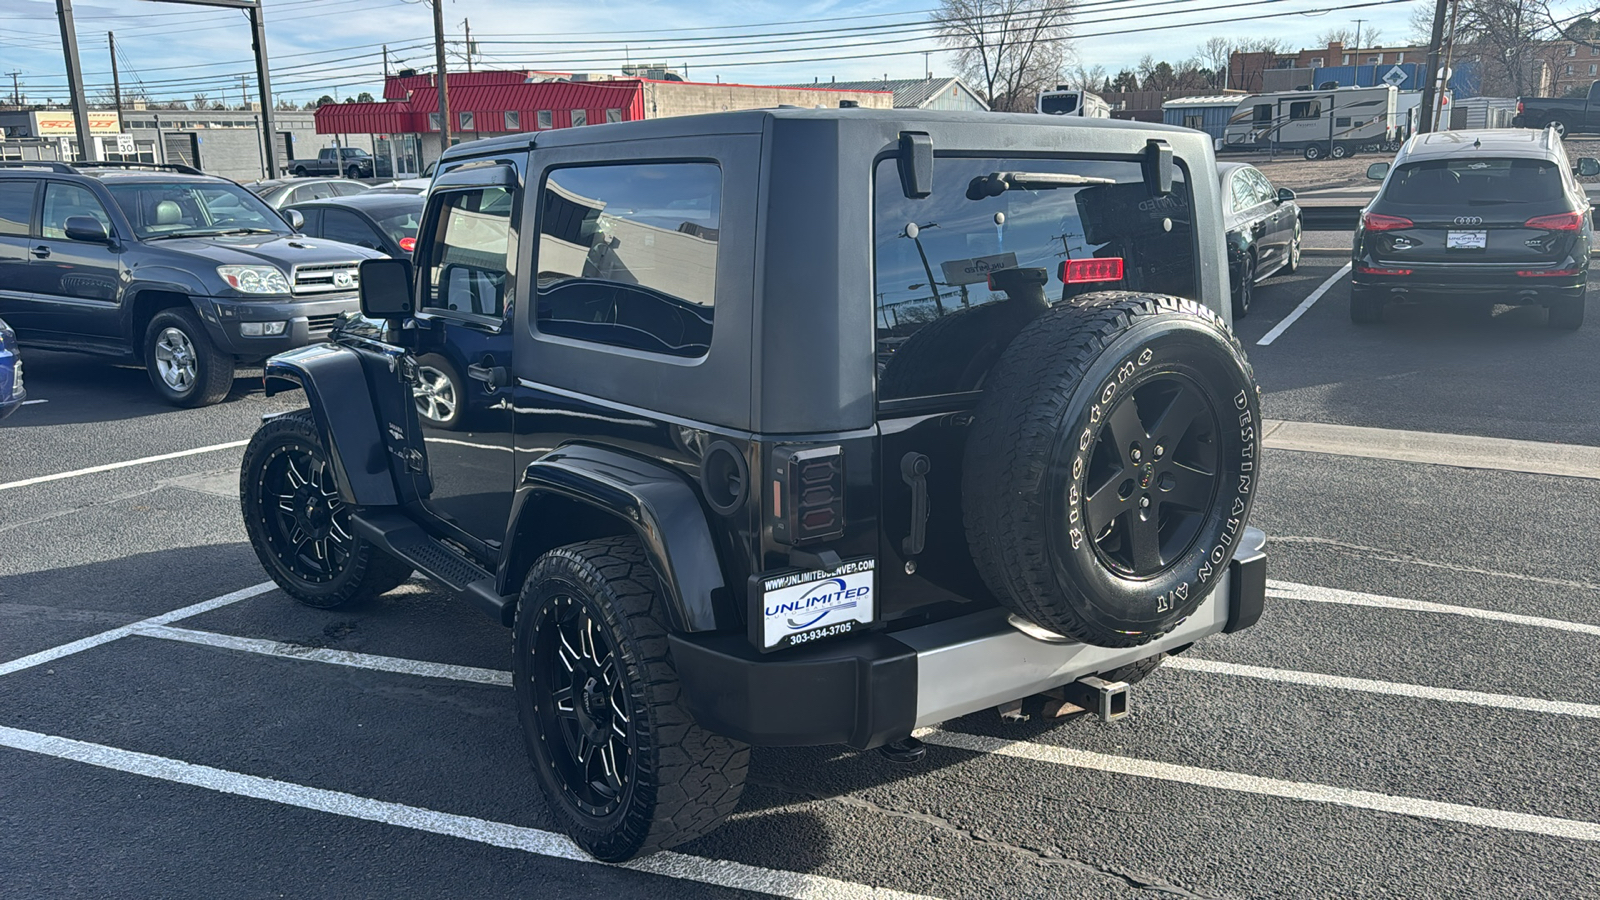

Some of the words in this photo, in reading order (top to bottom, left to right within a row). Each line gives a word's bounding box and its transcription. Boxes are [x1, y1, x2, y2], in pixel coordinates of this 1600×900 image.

[120, 144, 133, 153] 30
[1198, 389, 1254, 583] DESTINATION
[765, 586, 870, 616] UNLIMITED
[1156, 582, 1190, 614] A/T
[790, 622, 852, 645] 303-934-3705
